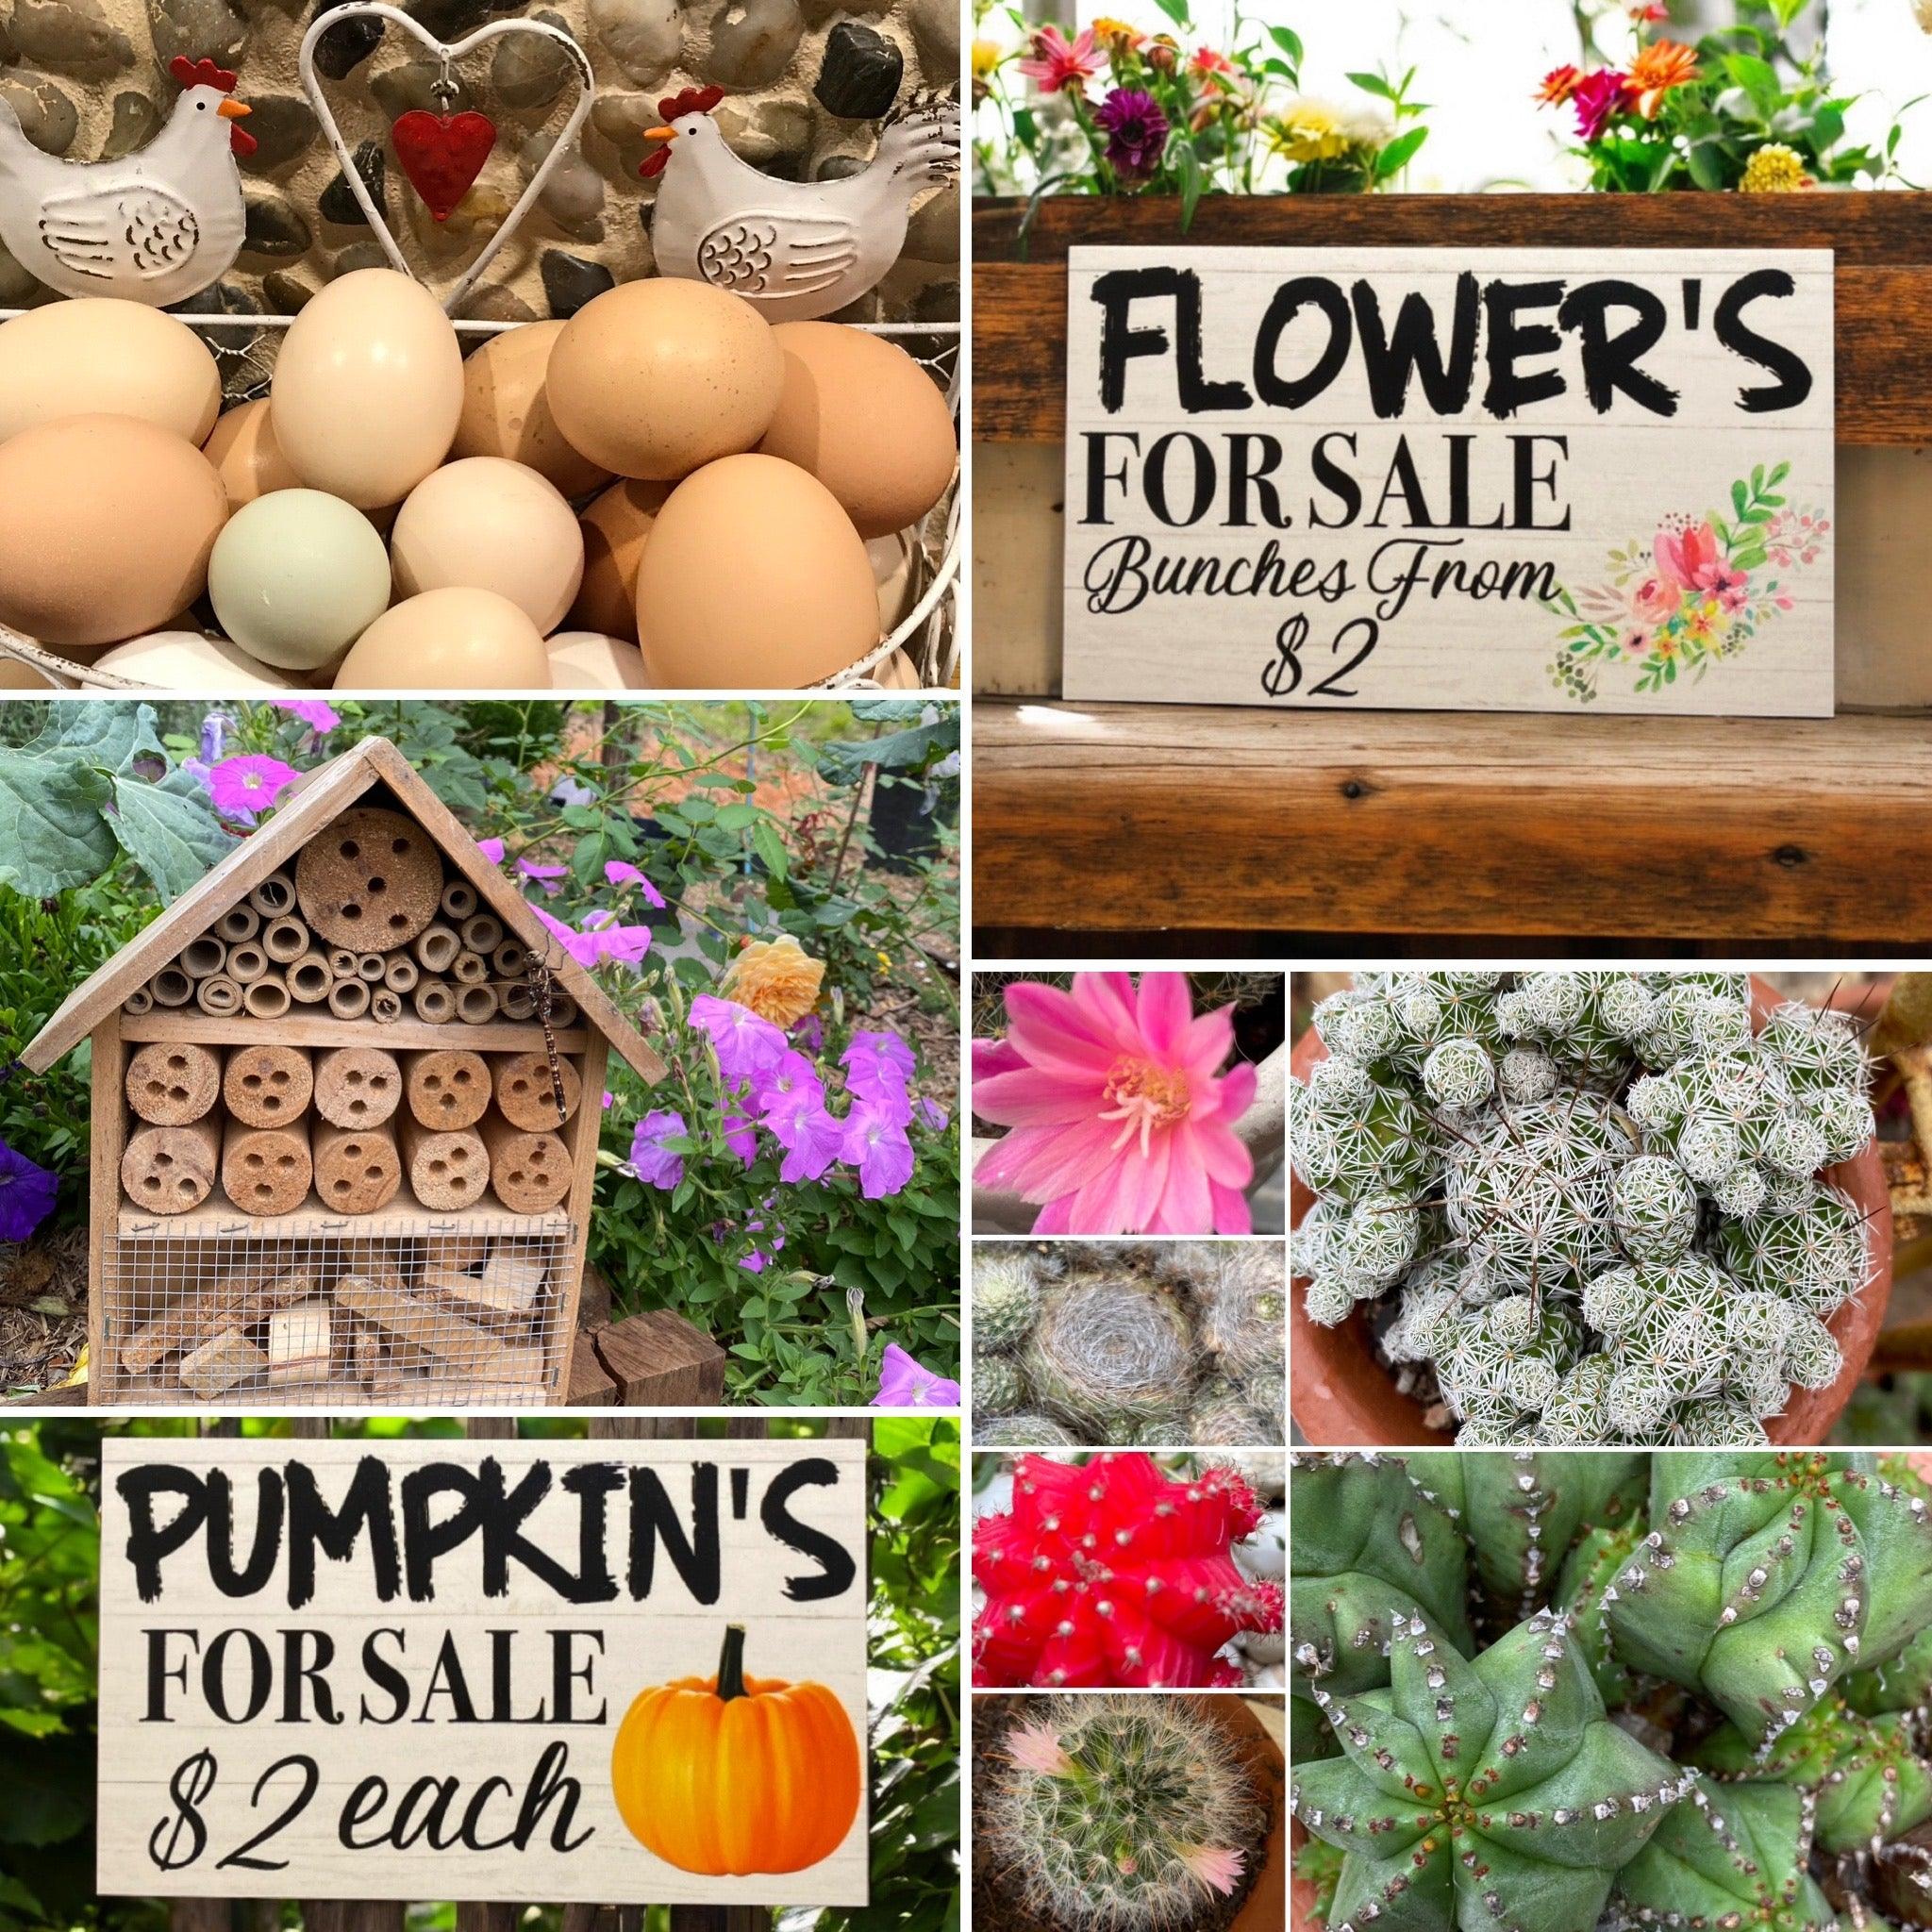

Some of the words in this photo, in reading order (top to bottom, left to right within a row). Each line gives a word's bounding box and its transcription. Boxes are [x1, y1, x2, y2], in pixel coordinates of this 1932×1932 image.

[1090, 266, 1813, 421] FLOWER'S
[1076, 431, 1292, 529] FOR
[1308, 432, 1571, 532] SALE
[1083, 535, 1357, 615] Bunches
[1367, 537, 1563, 622] From
[1260, 611, 1379, 698] $2
[115, 1455, 857, 1611] PUMPKIN'S
[139, 1627, 345, 1725] FOR
[359, 1627, 607, 1725] SALE
[148, 1747, 320, 1872] $2
[338, 1740, 596, 1854] each
